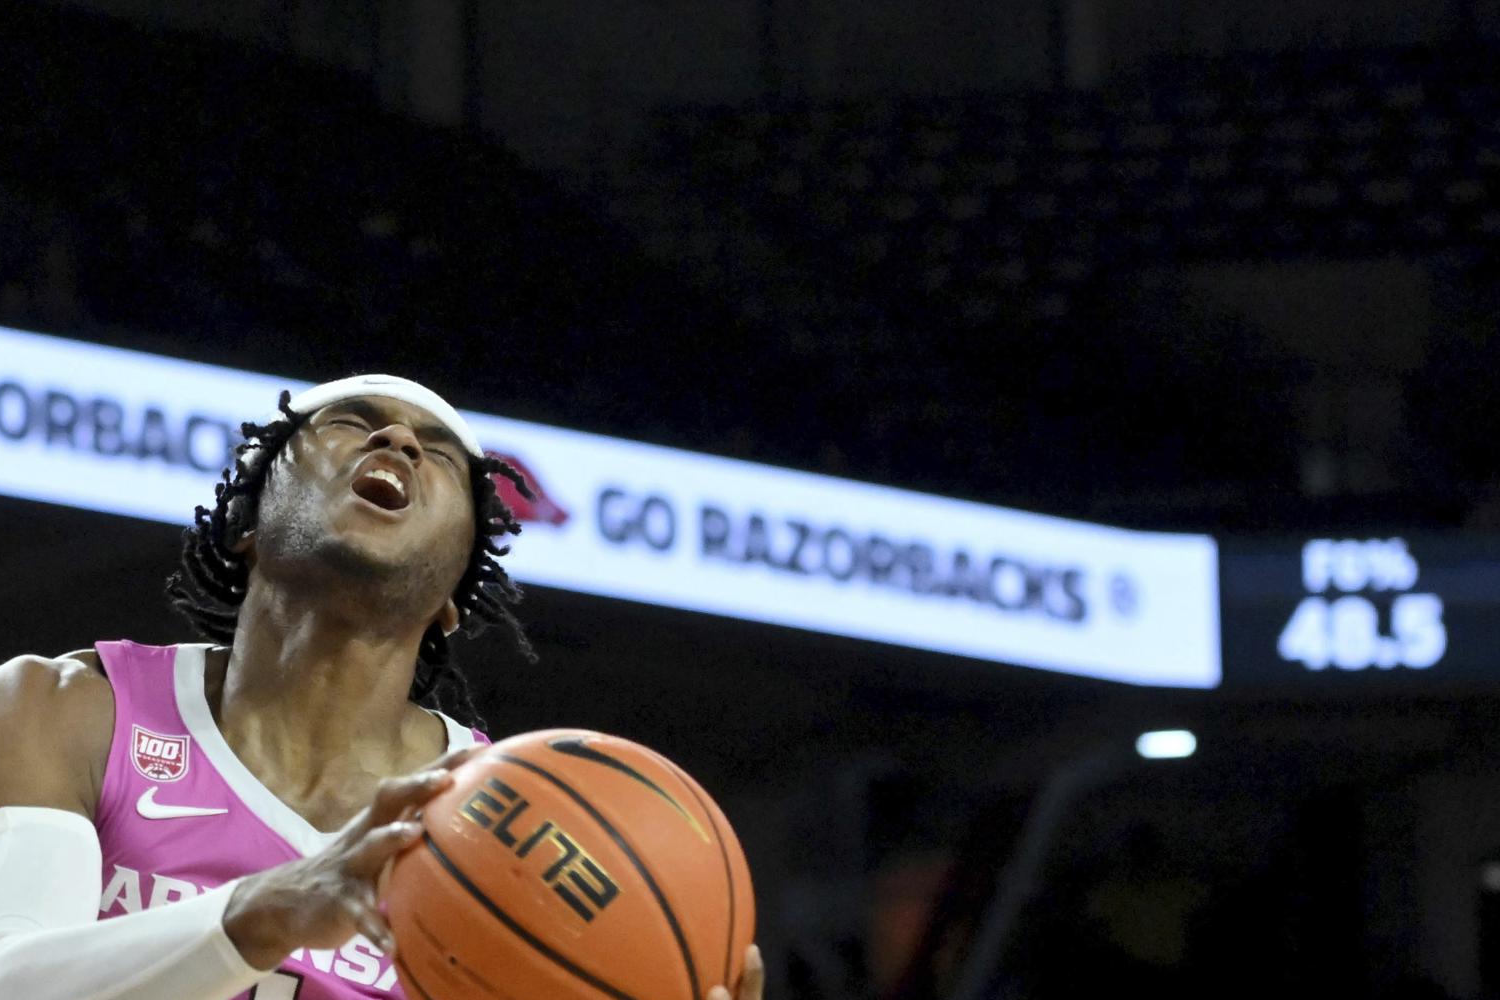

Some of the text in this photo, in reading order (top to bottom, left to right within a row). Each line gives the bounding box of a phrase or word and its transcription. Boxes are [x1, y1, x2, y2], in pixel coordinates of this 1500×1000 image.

[595, 487, 678, 555] GO
[698, 504, 1089, 625] RAZORBACKS
[139, 735, 180, 761] 100
[461, 777, 621, 923] ELITE
